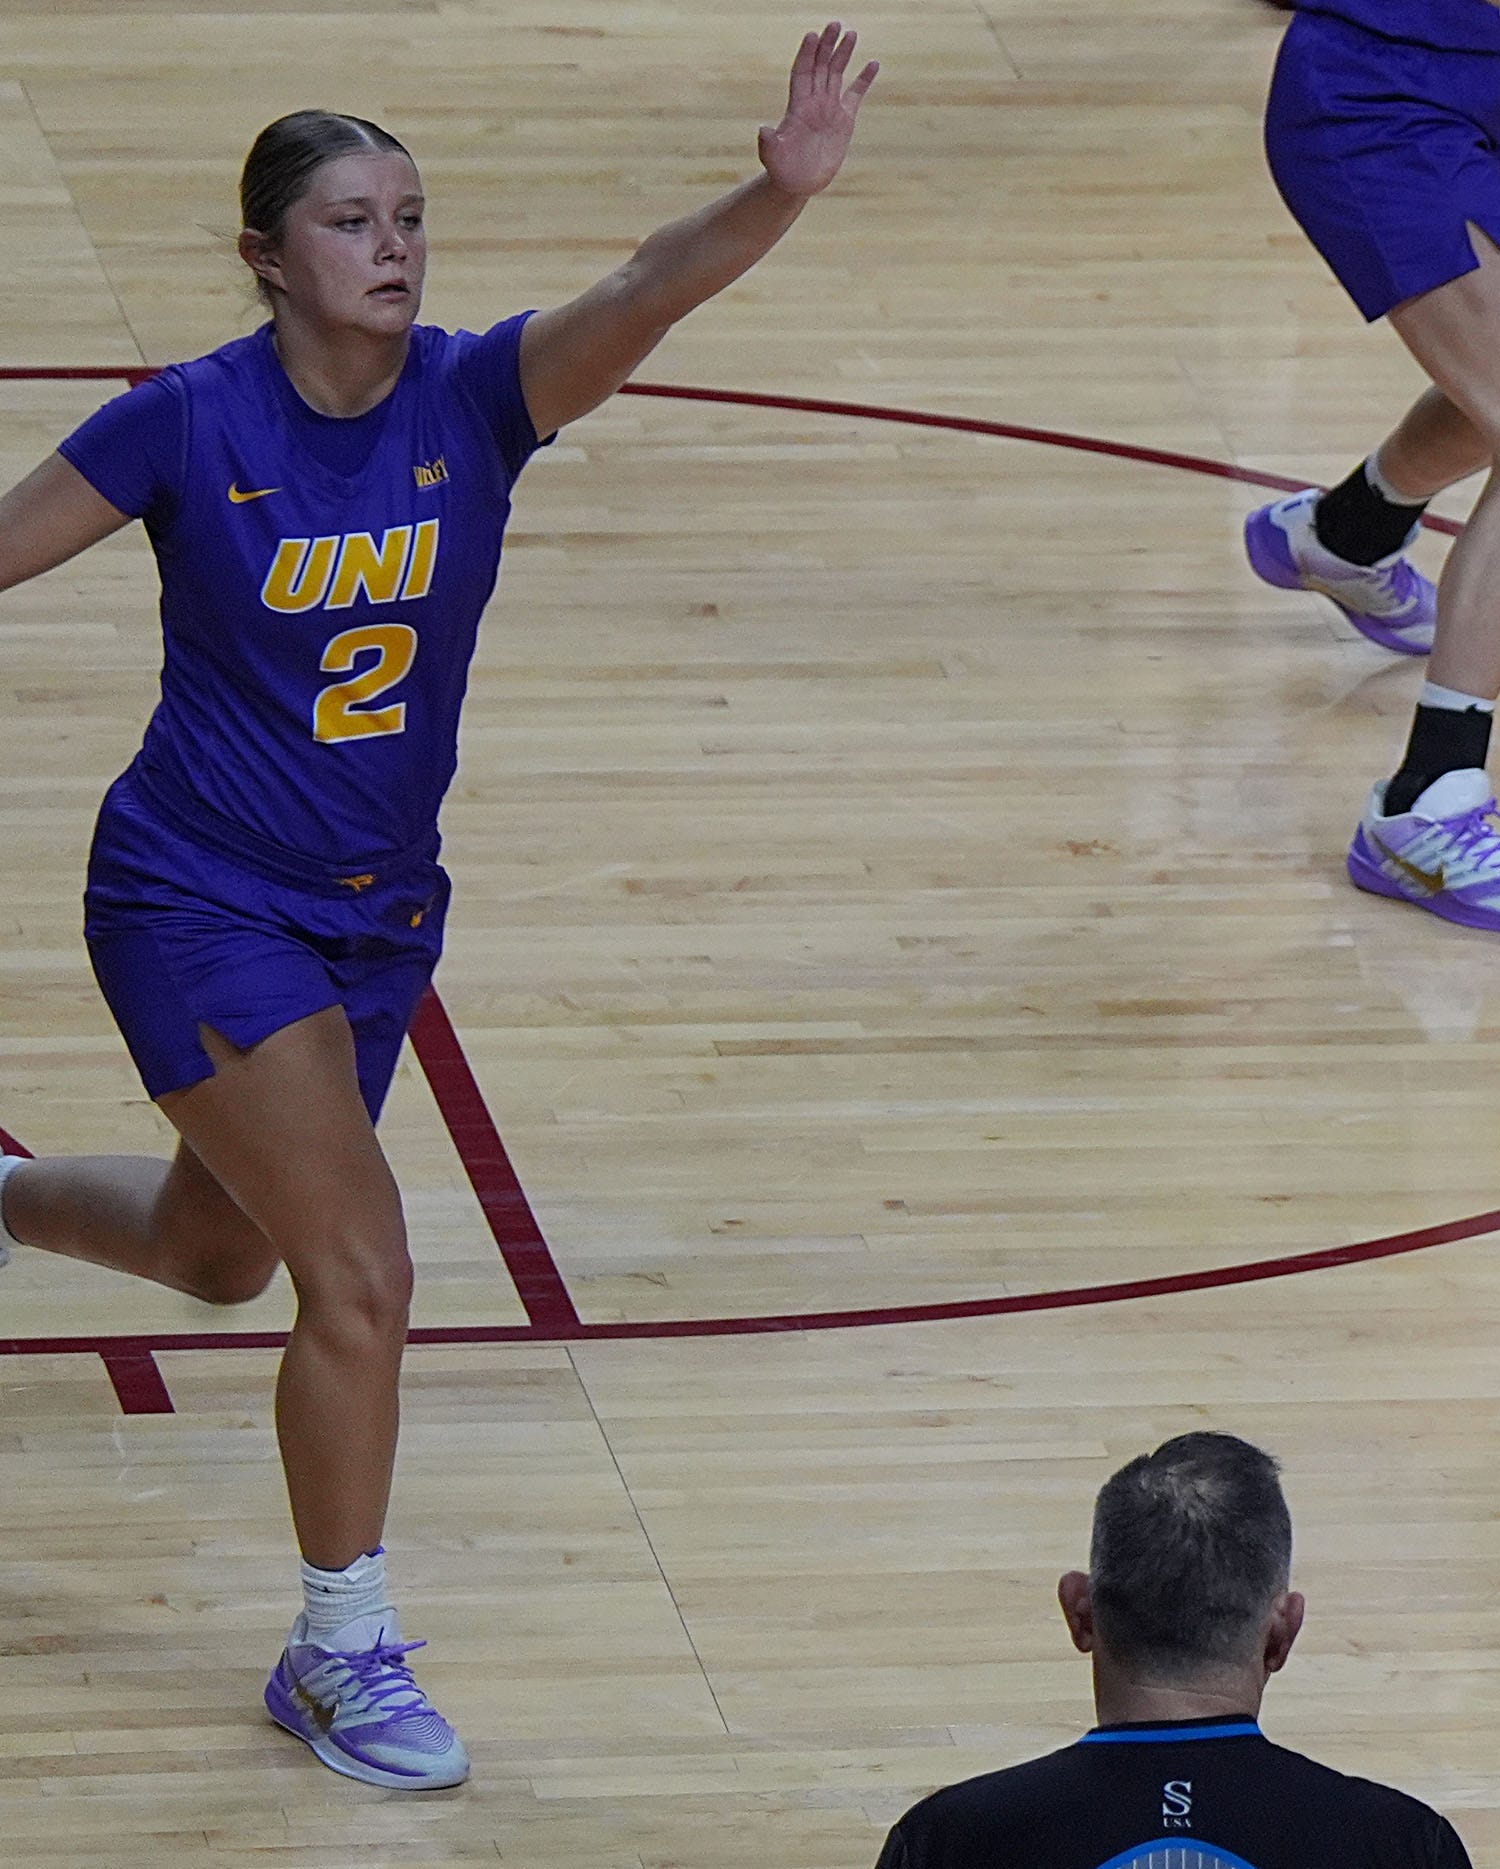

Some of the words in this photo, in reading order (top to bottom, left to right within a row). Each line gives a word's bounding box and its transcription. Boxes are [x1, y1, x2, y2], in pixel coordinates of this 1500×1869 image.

[261, 518, 439, 613] UNI
[313, 623, 418, 744] 2
[1163, 1781, 1191, 1815] S
[1163, 1818, 1191, 1827] USA
